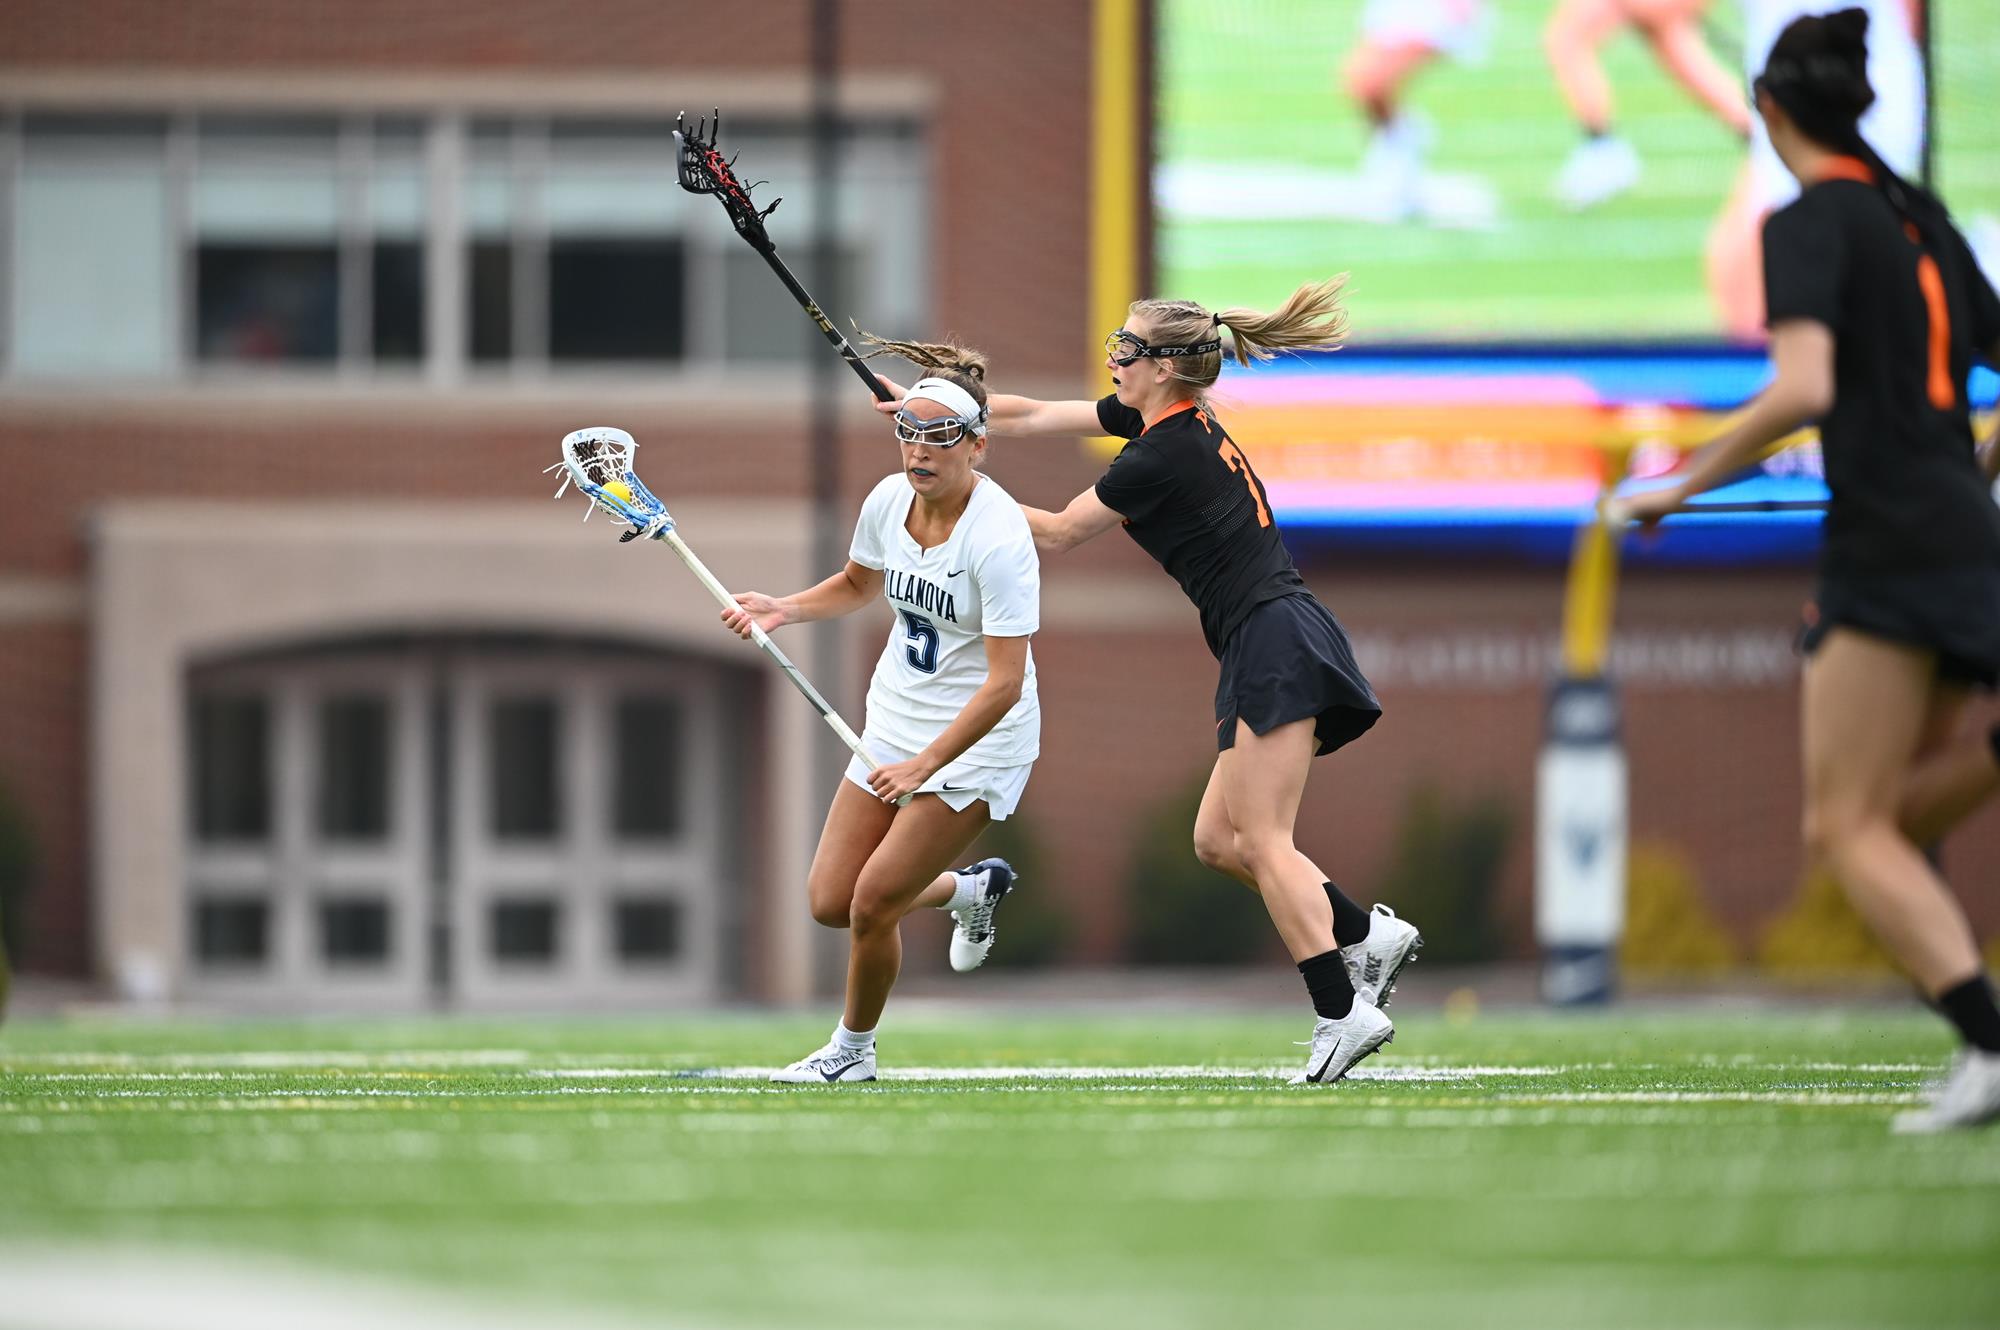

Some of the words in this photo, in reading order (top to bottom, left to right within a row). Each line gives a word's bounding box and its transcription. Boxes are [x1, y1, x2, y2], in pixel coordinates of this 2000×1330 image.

[1161, 347, 1189, 356] STX
[1198, 342, 1218, 354] STX
[898, 607, 940, 674] 5
